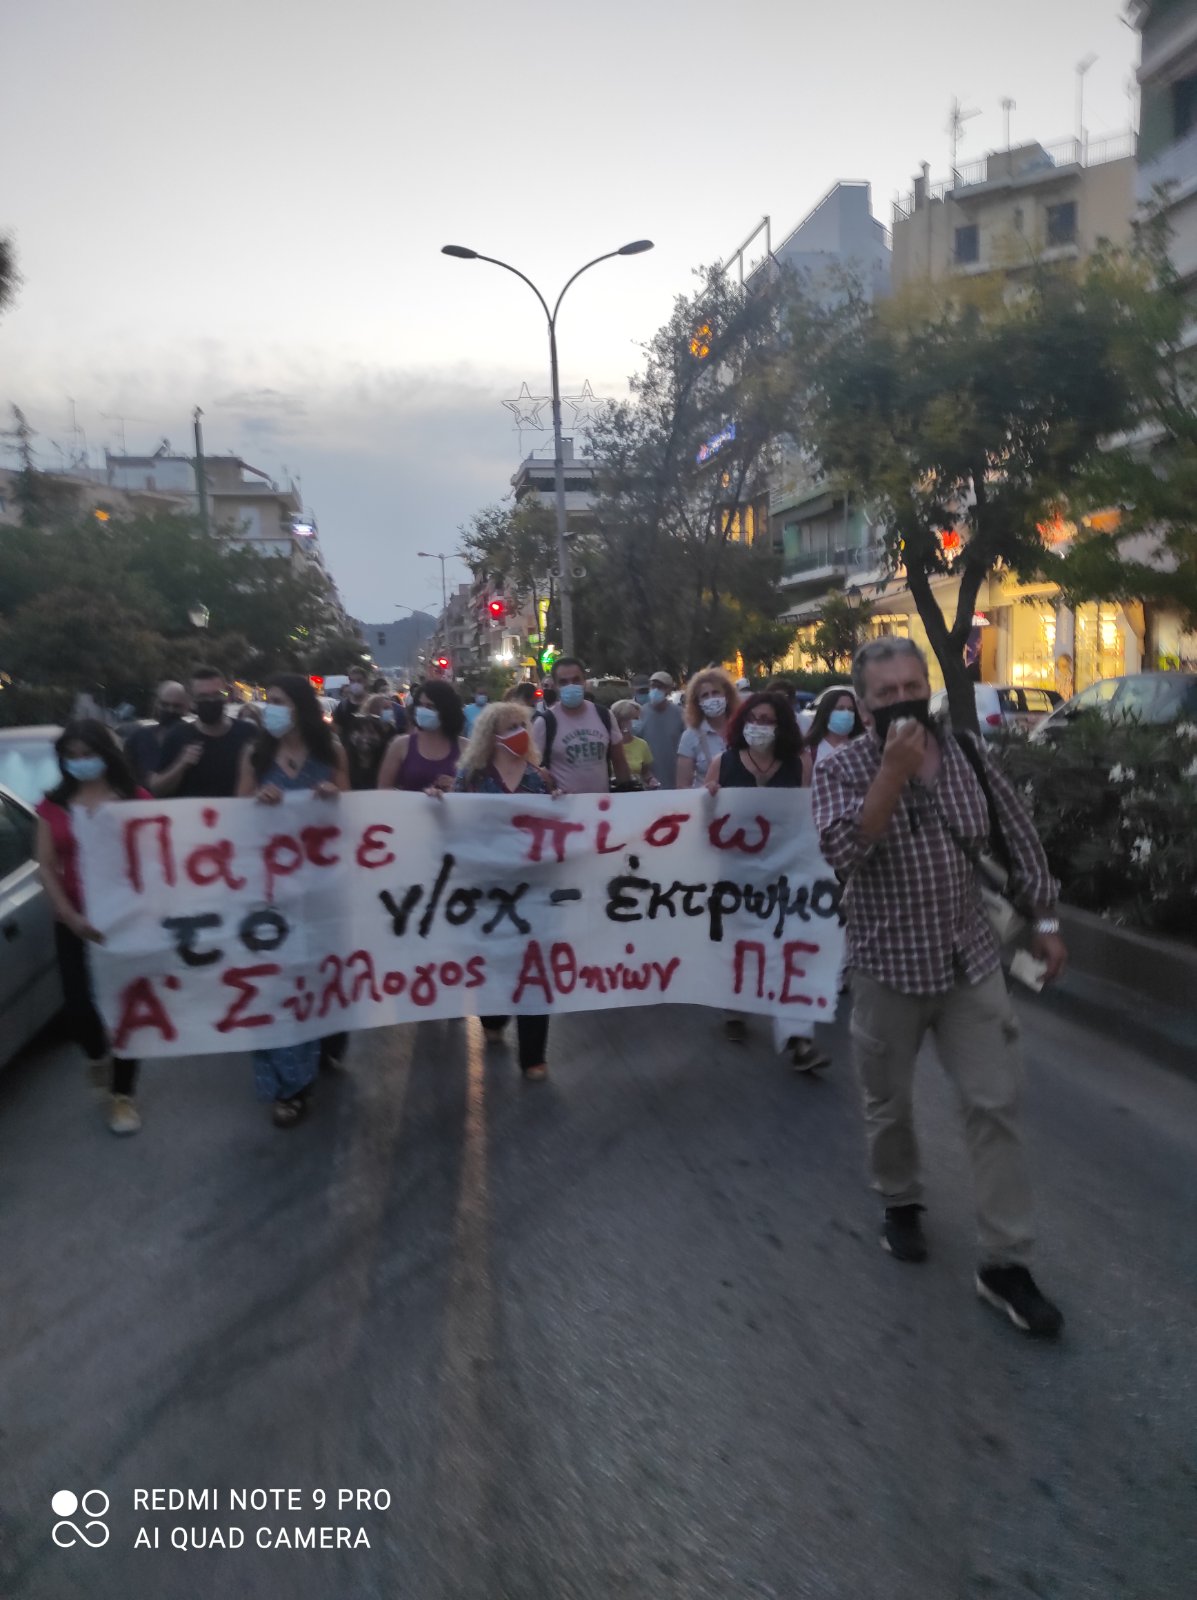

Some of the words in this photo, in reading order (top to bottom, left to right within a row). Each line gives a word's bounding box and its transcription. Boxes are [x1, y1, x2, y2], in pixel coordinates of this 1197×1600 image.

[123, 806, 397, 902] Πάρτε
[511, 798, 770, 863] πίσω
[161, 910, 289, 967] το
[213, 949, 486, 1033] Σύλλογος
[511, 939, 681, 1005] Αθηνών
[733, 940, 828, 1008] Π.Ε.
